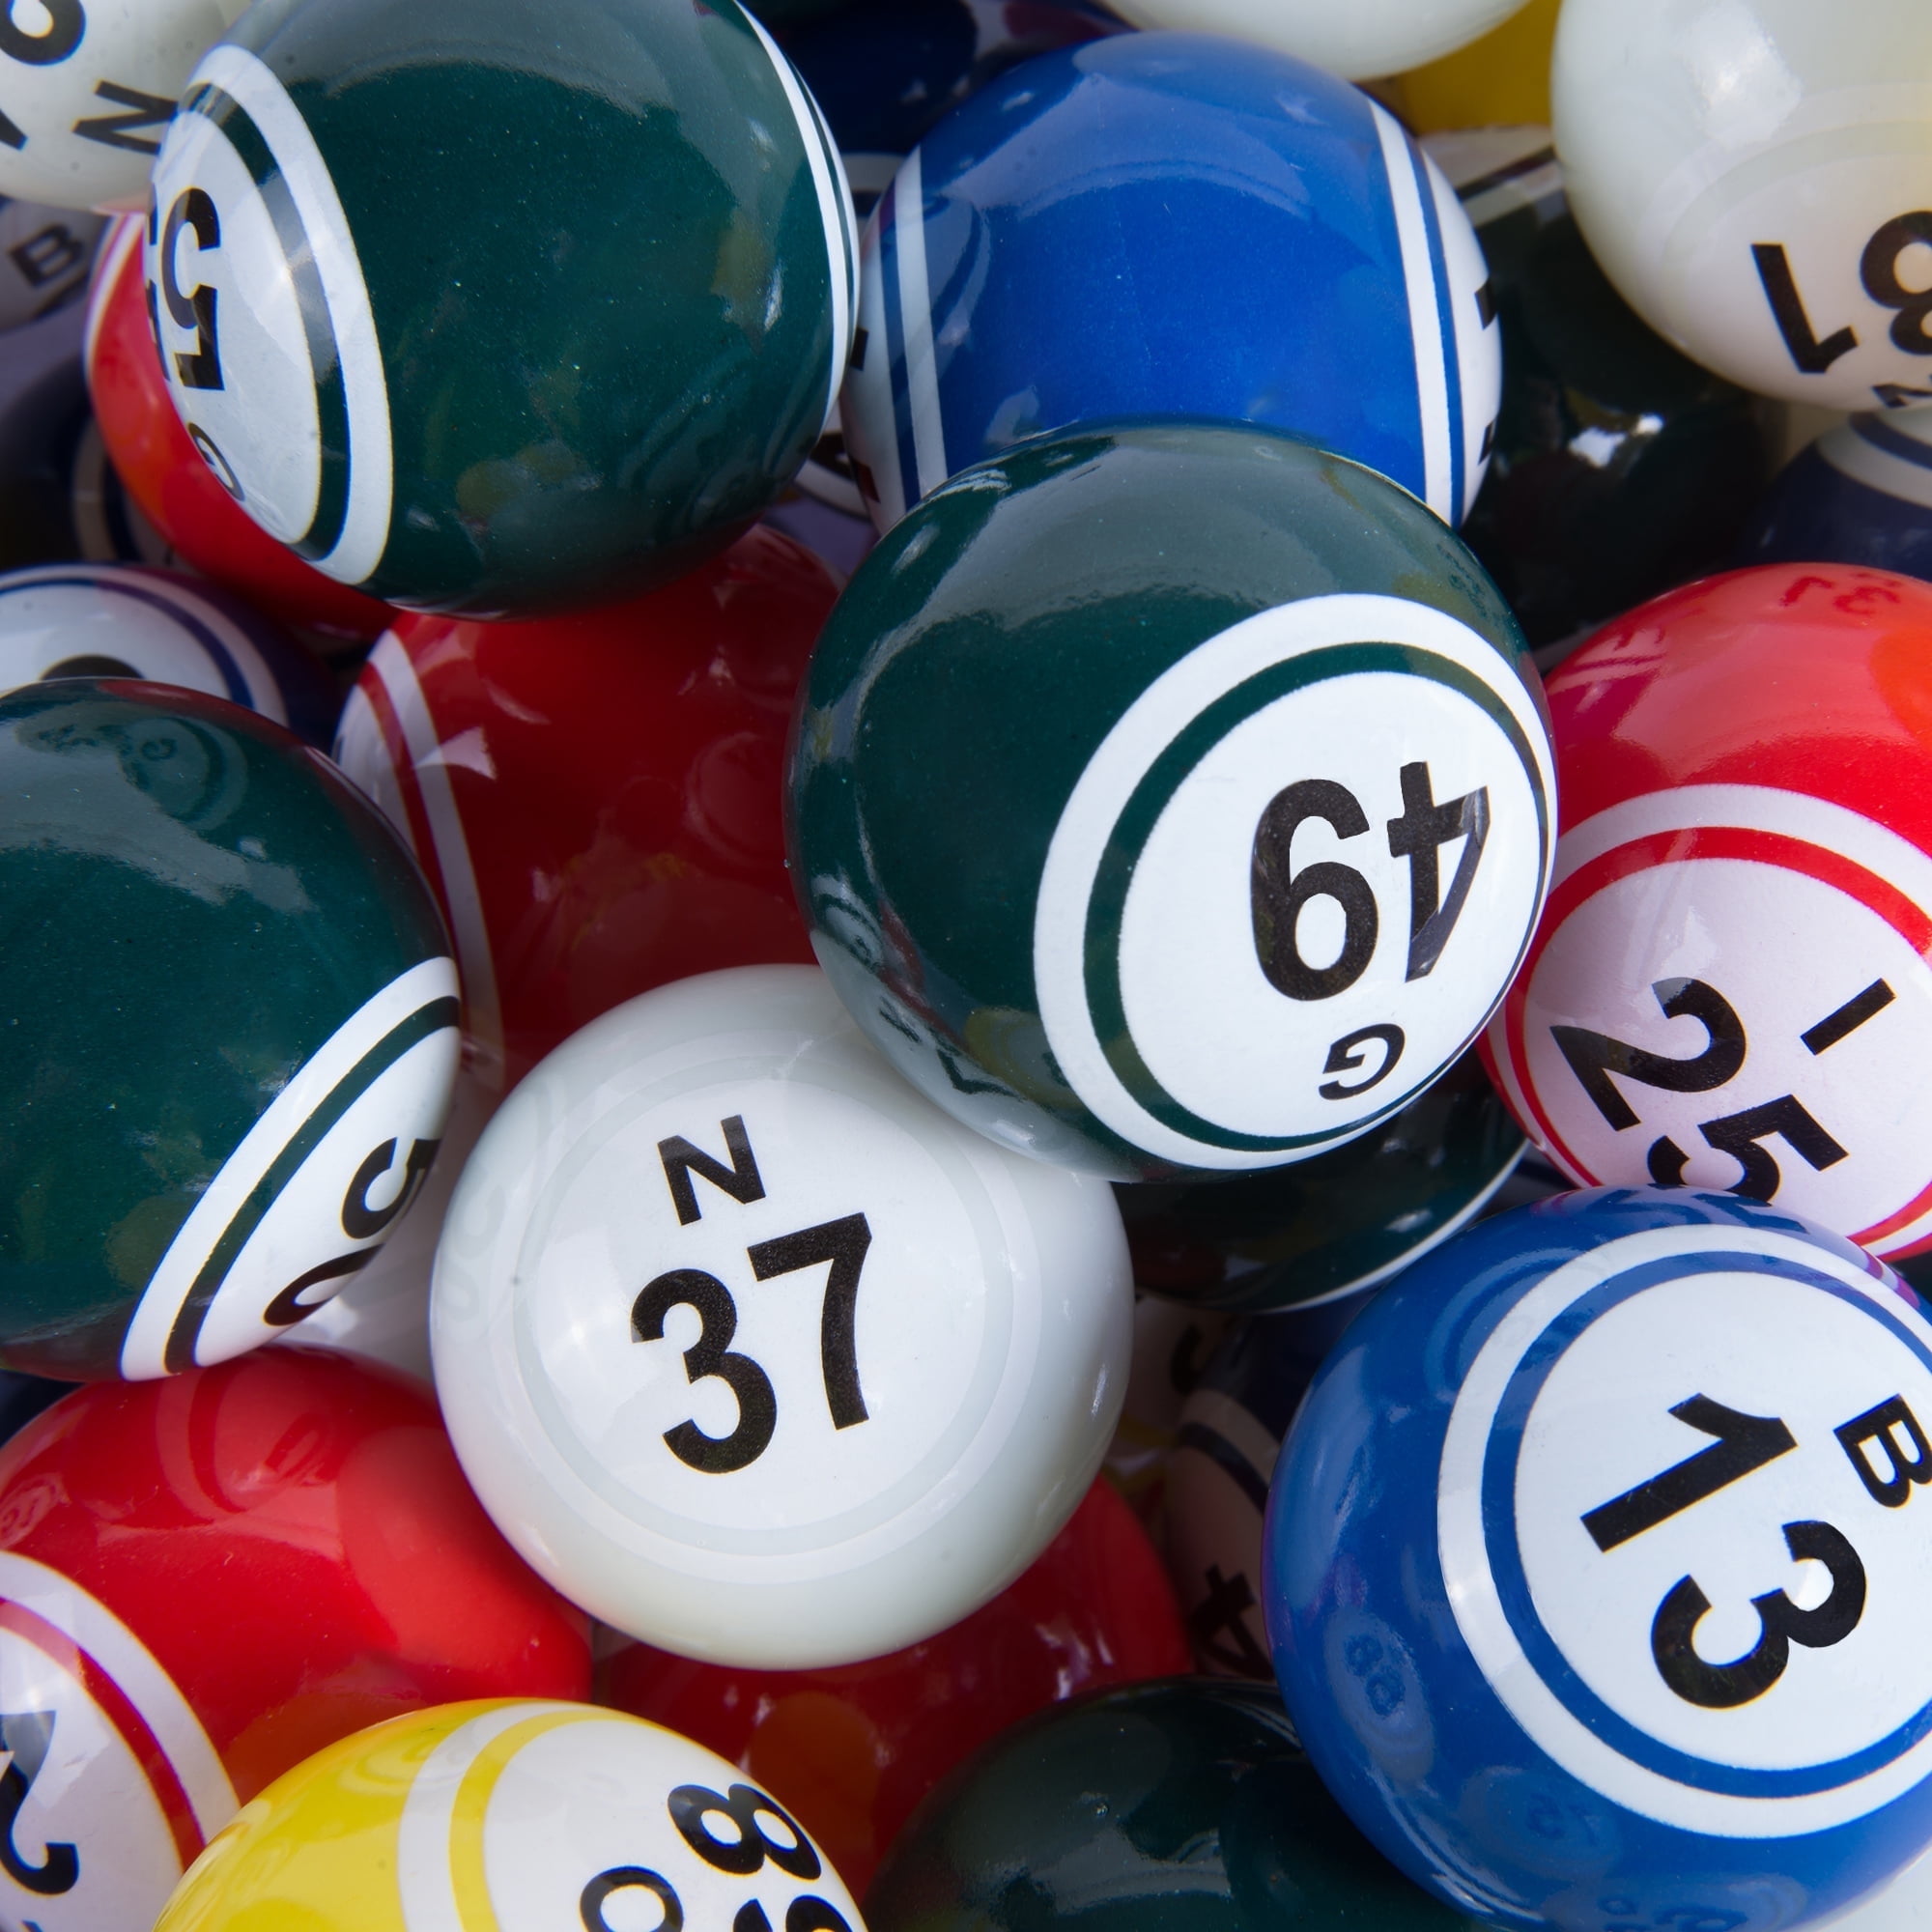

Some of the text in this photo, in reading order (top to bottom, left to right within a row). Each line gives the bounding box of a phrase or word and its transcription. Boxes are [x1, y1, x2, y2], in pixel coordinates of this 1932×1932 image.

[145, 187, 225, 391] 5
[1250, 760, 1490, 1002] 49
[1319, 1023, 1406, 1099] G
[1549, 977, 1849, 1207] 25
[657, 1115, 766, 1226] N
[630, 1212, 873, 1474] 37
[1833, 1393, 1932, 1508] B
[1580, 1393, 1867, 1709] 13
